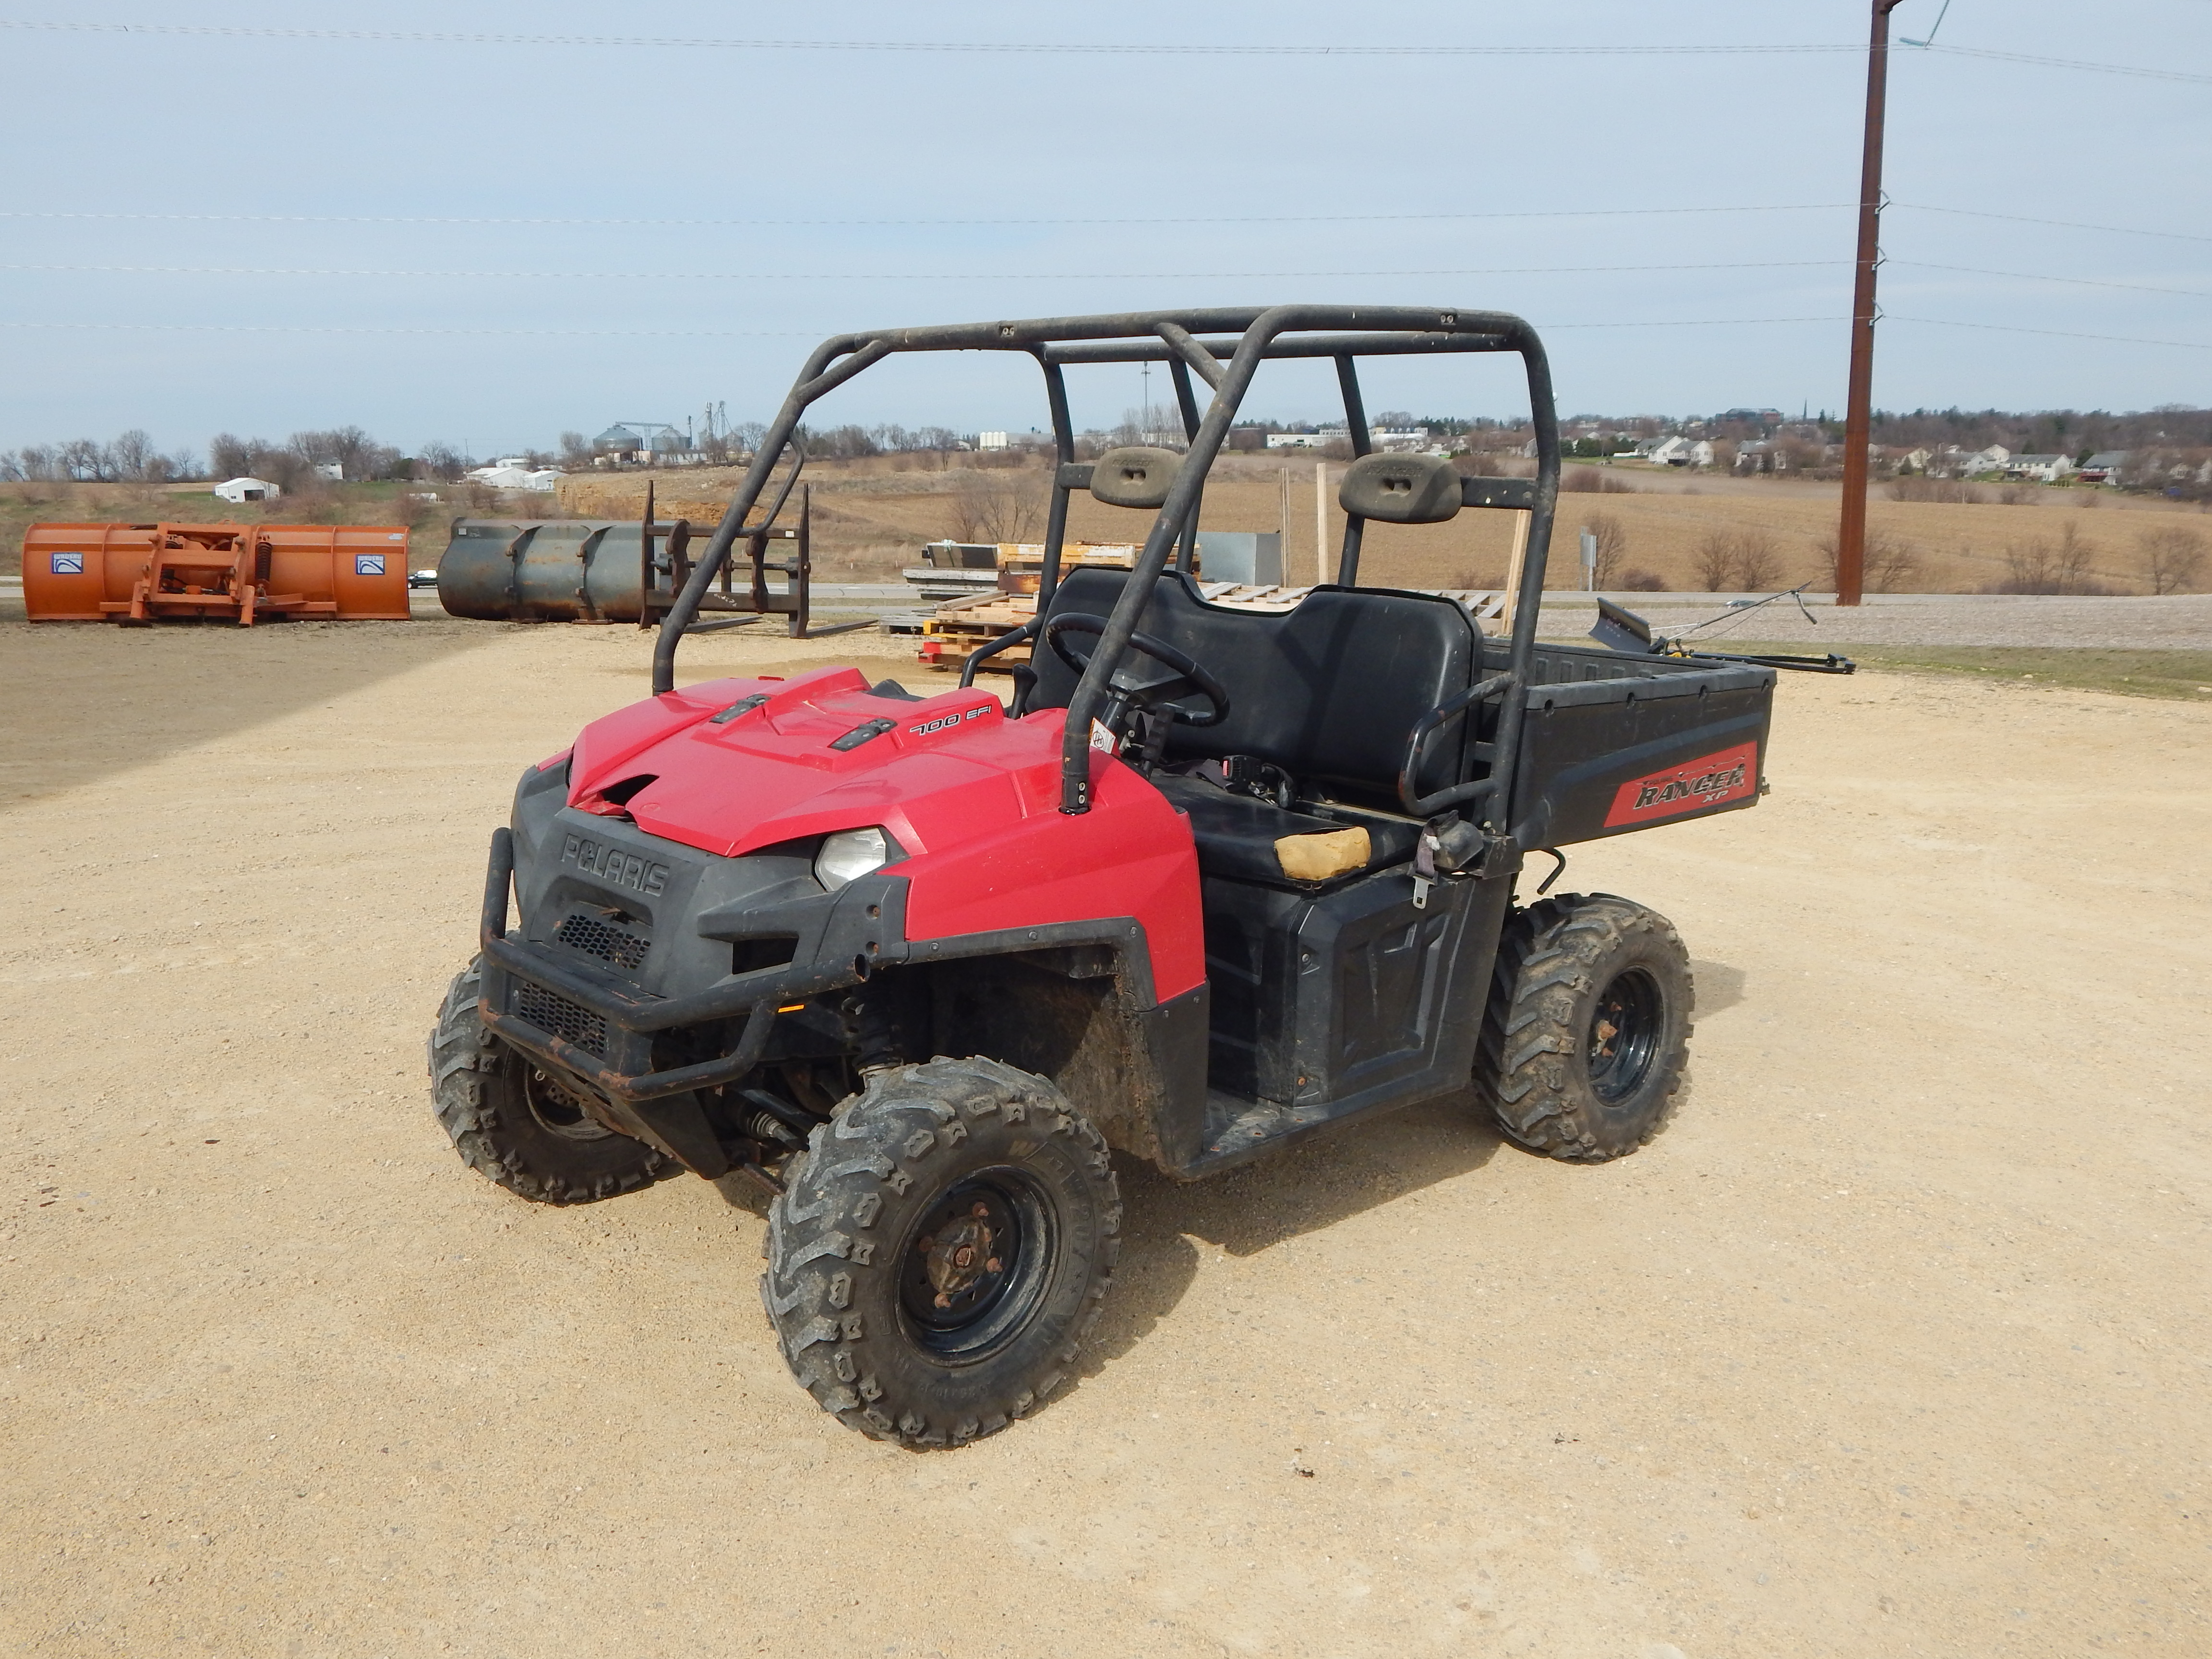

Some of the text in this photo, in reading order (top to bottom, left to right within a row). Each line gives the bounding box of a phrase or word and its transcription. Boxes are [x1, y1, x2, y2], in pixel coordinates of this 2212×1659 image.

[909, 704, 992, 736] 700 EFI
[1633, 766, 1745, 810] RANGER
[1702, 790, 1729, 804] XP
[561, 833, 670, 897] POLARIS
